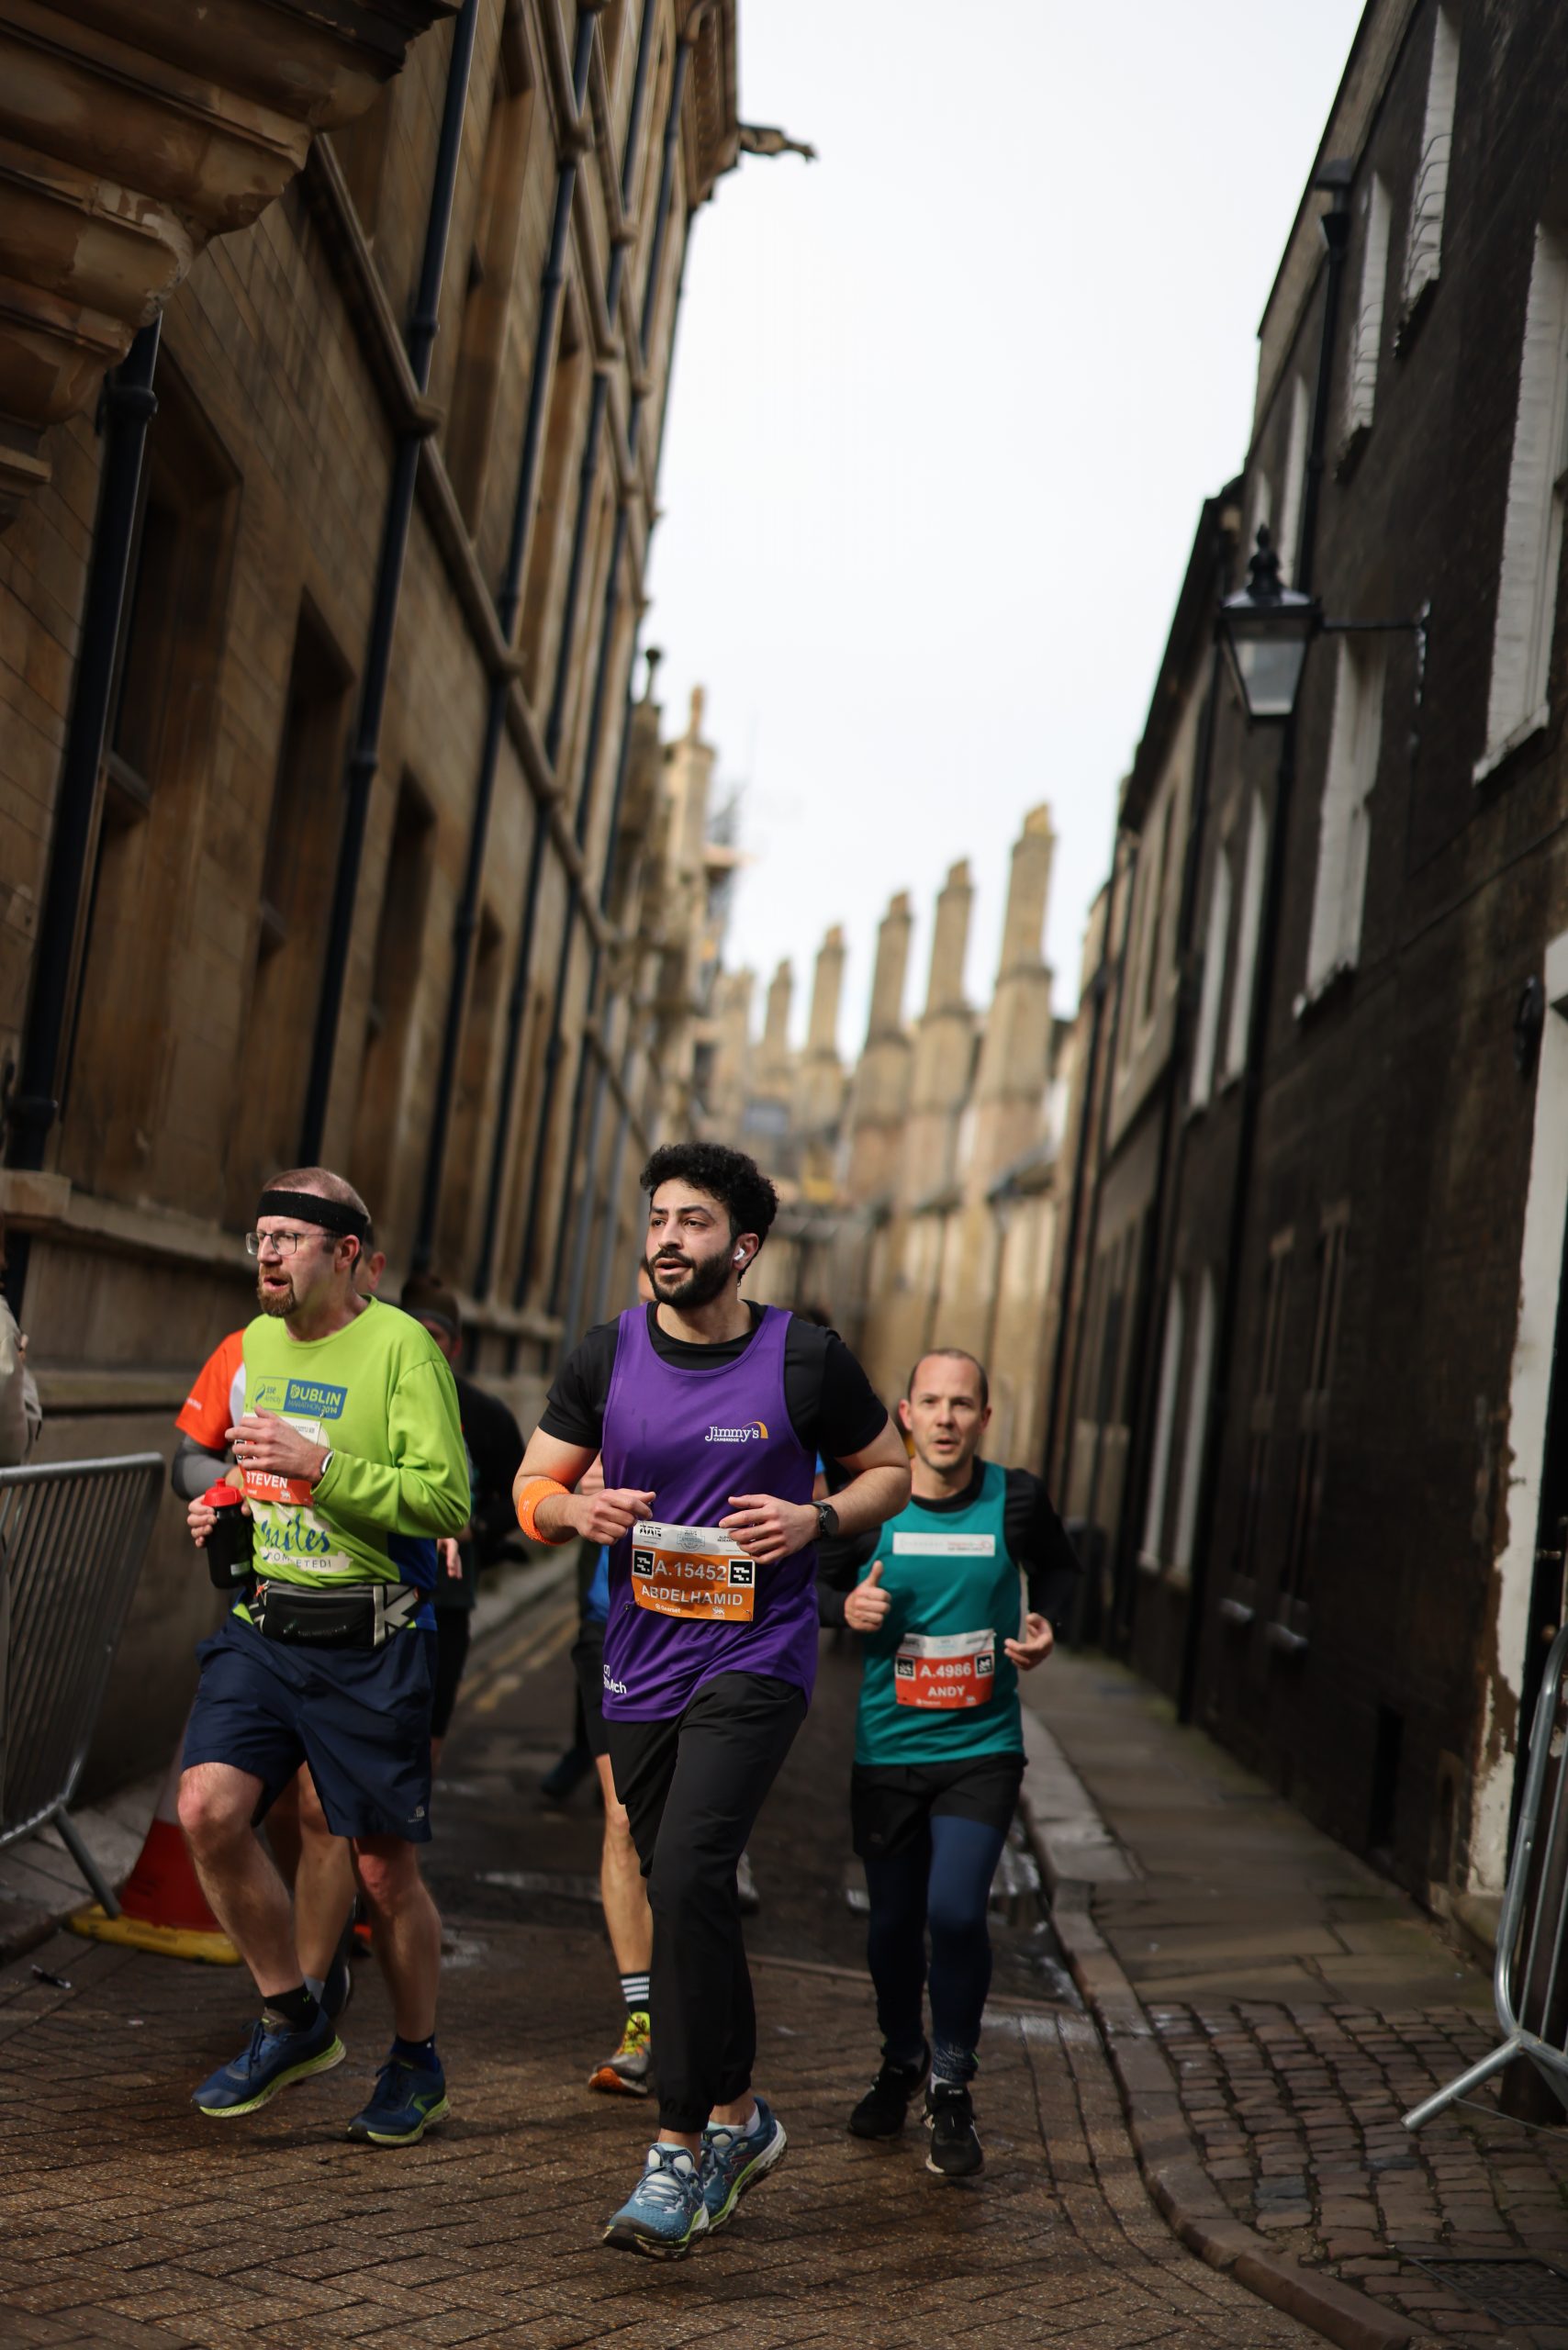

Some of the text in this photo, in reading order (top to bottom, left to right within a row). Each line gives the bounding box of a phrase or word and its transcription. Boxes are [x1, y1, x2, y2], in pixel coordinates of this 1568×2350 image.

[290, 1384, 342, 1406] DUBLIN
[704, 1426, 760, 1443] Jimmy's
[245, 1471, 288, 1489] STEVEN
[260, 1514, 330, 1553] miles
[653, 1560, 727, 1582] A.15452
[642, 1584, 743, 1606] ABDELHAMID
[920, 1662, 972, 1679] A.4986
[927, 1685, 966, 1697] ANDY
